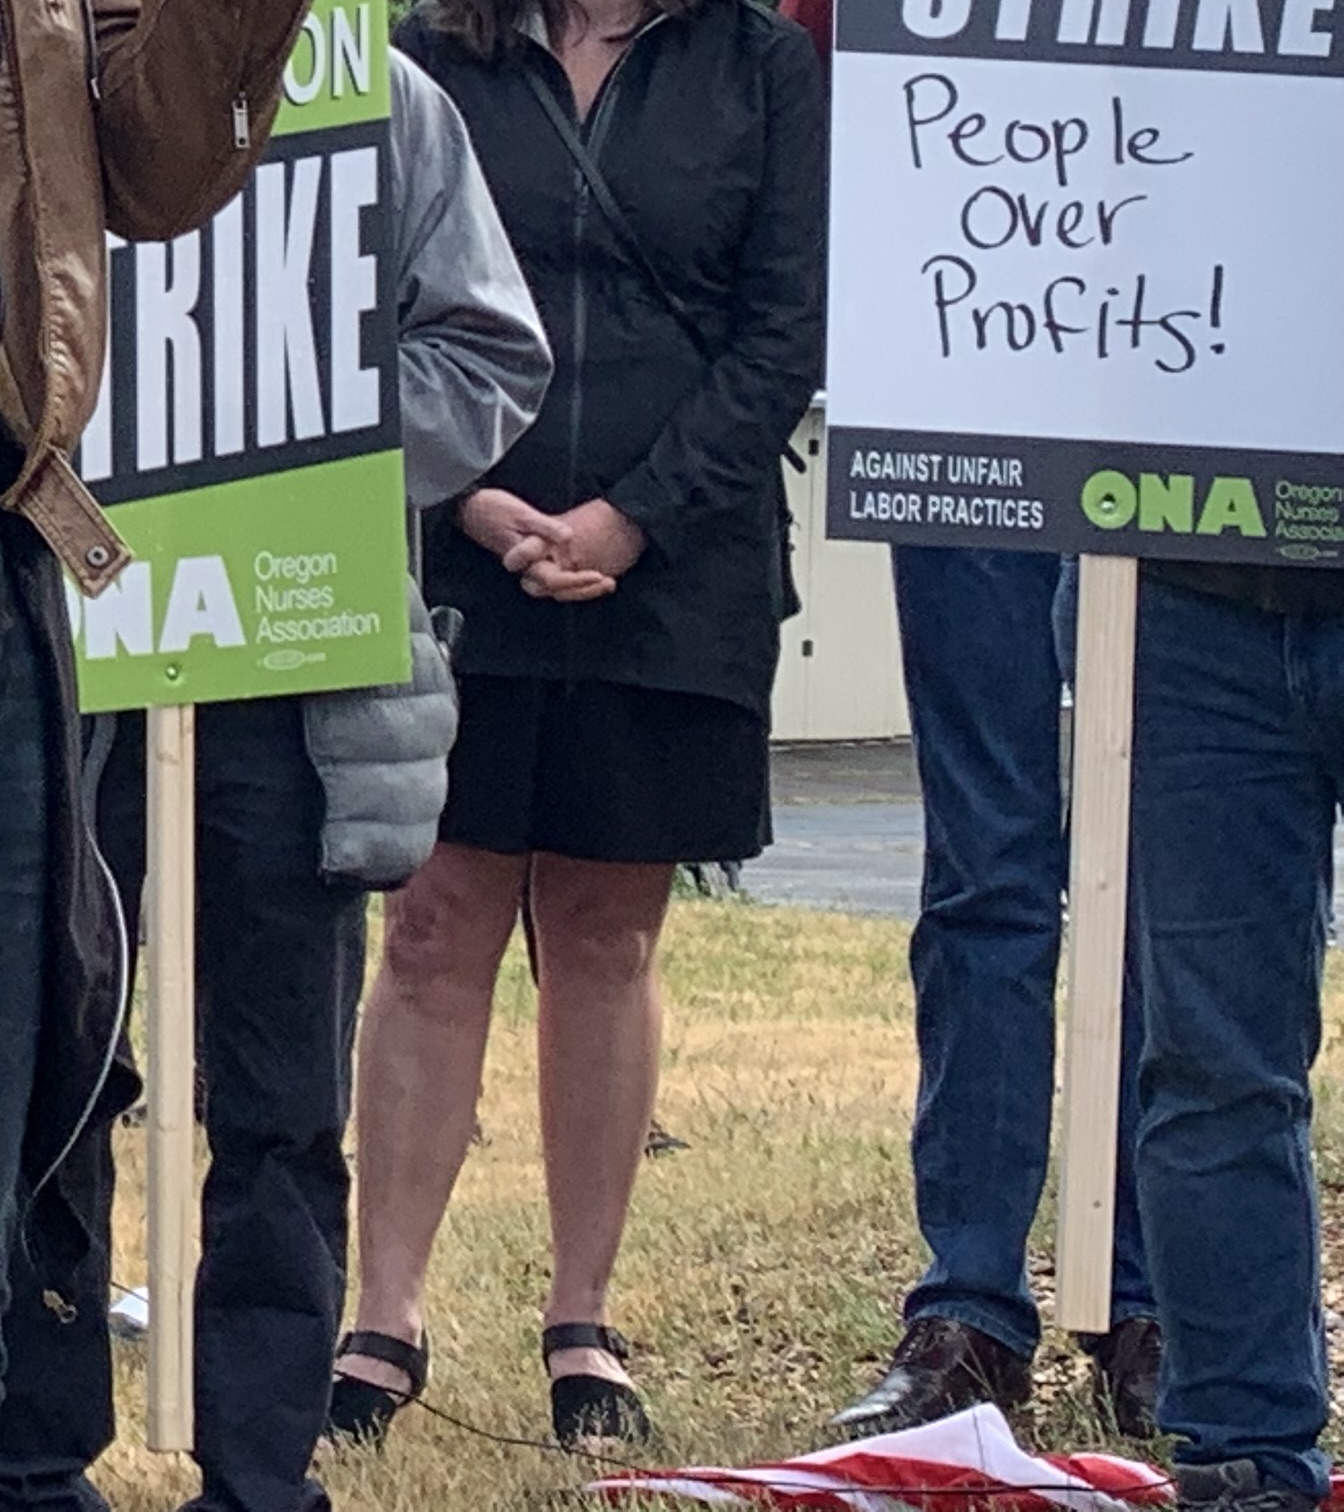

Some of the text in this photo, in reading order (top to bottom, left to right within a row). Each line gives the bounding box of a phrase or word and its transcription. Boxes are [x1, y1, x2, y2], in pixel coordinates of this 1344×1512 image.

[903, 72, 1195, 187] People
[920, 253, 1226, 373] Profits!
[849, 449, 1023, 487] AGAINST UNFAIR
[849, 489, 1044, 529] LABOR PRACTICES
[1081, 469, 1268, 537] ONA
[1274, 479, 1344, 505] Oregon
[1274, 501, 1340, 523] Nurses
[253, 550, 337, 583] Oregon
[64, 553, 248, 660] NA
[255, 584, 335, 615] Nurses
[255, 610, 382, 644] Association
